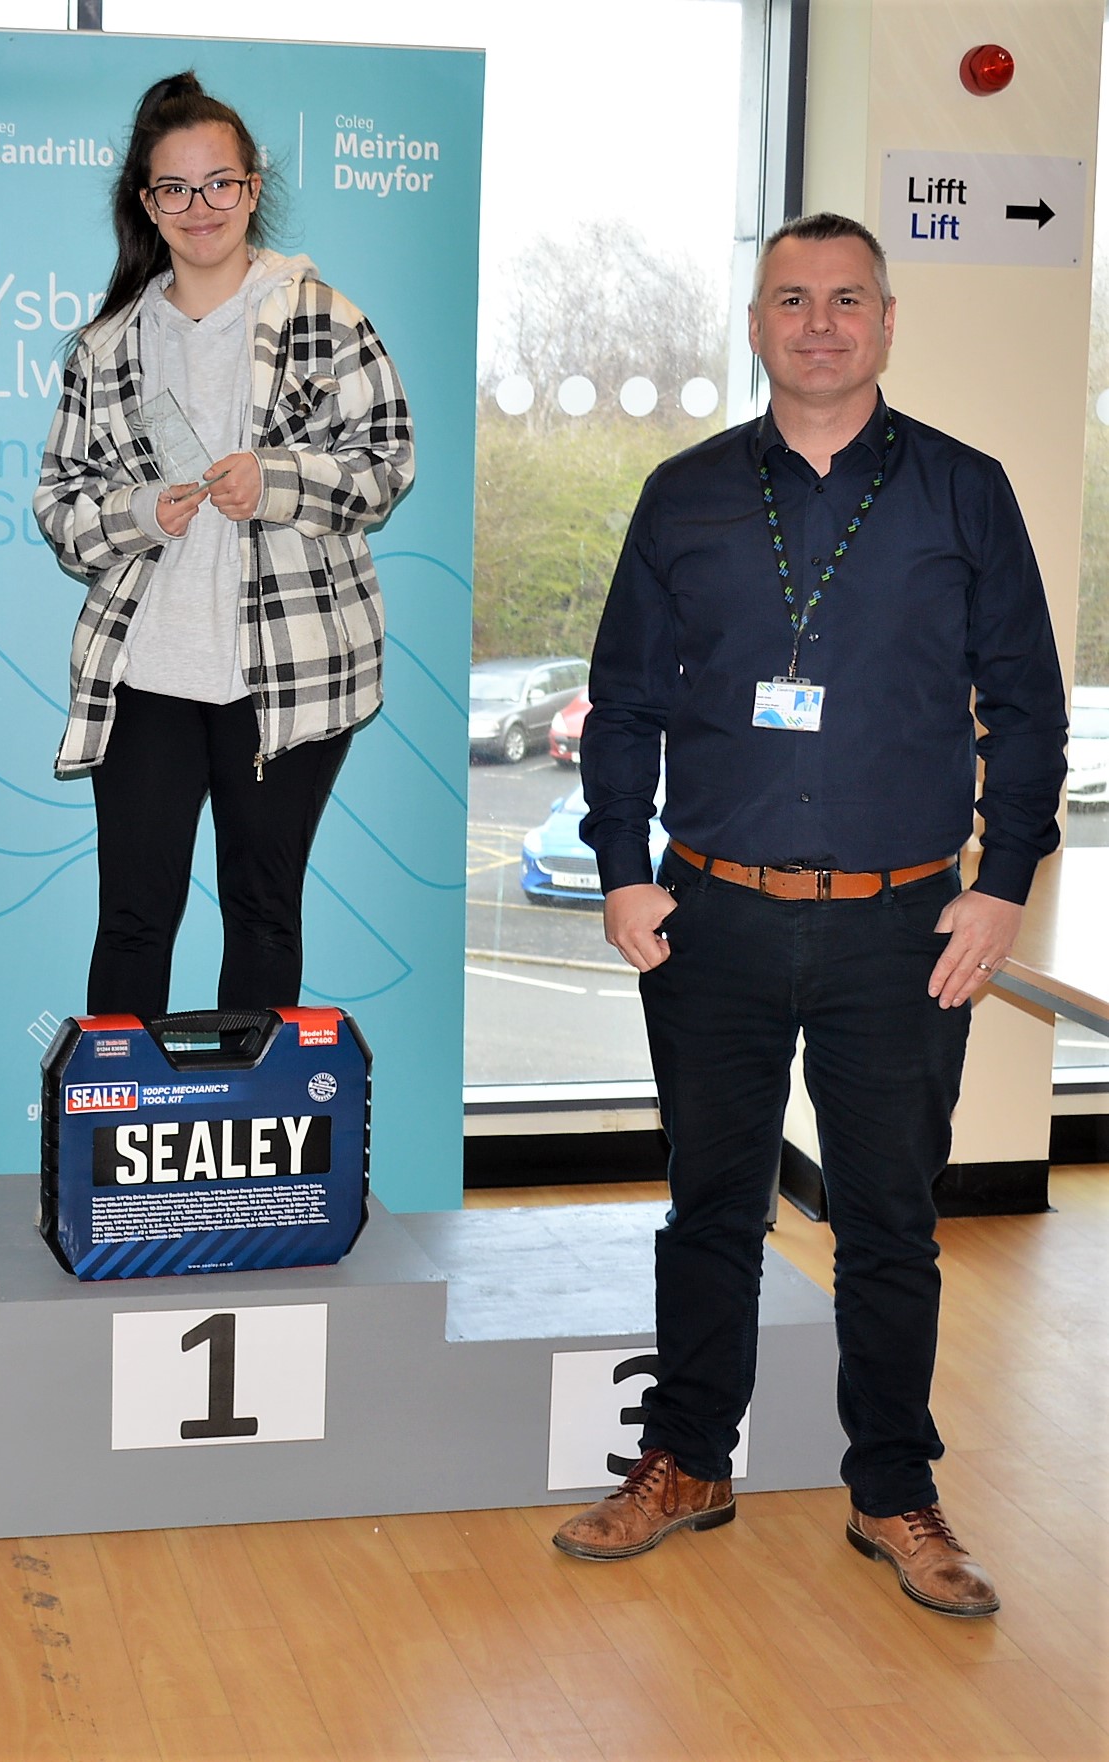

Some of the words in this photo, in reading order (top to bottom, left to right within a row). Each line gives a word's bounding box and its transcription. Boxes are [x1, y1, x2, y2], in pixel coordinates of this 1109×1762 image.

[335, 114, 374, 132] Coleg
[334, 132, 439, 161] Meirion
[334, 164, 434, 198] Dwyfor
[908, 176, 967, 204] Lifft
[911, 213, 960, 240] Lift
[72, 1086, 132, 1109] SEALEY
[142, 1088, 170, 1096] 100PC
[172, 1084, 229, 1094] MECHANIC'S
[116, 1116, 312, 1184] SEALEY
[180, 1313, 258, 1440] 1
